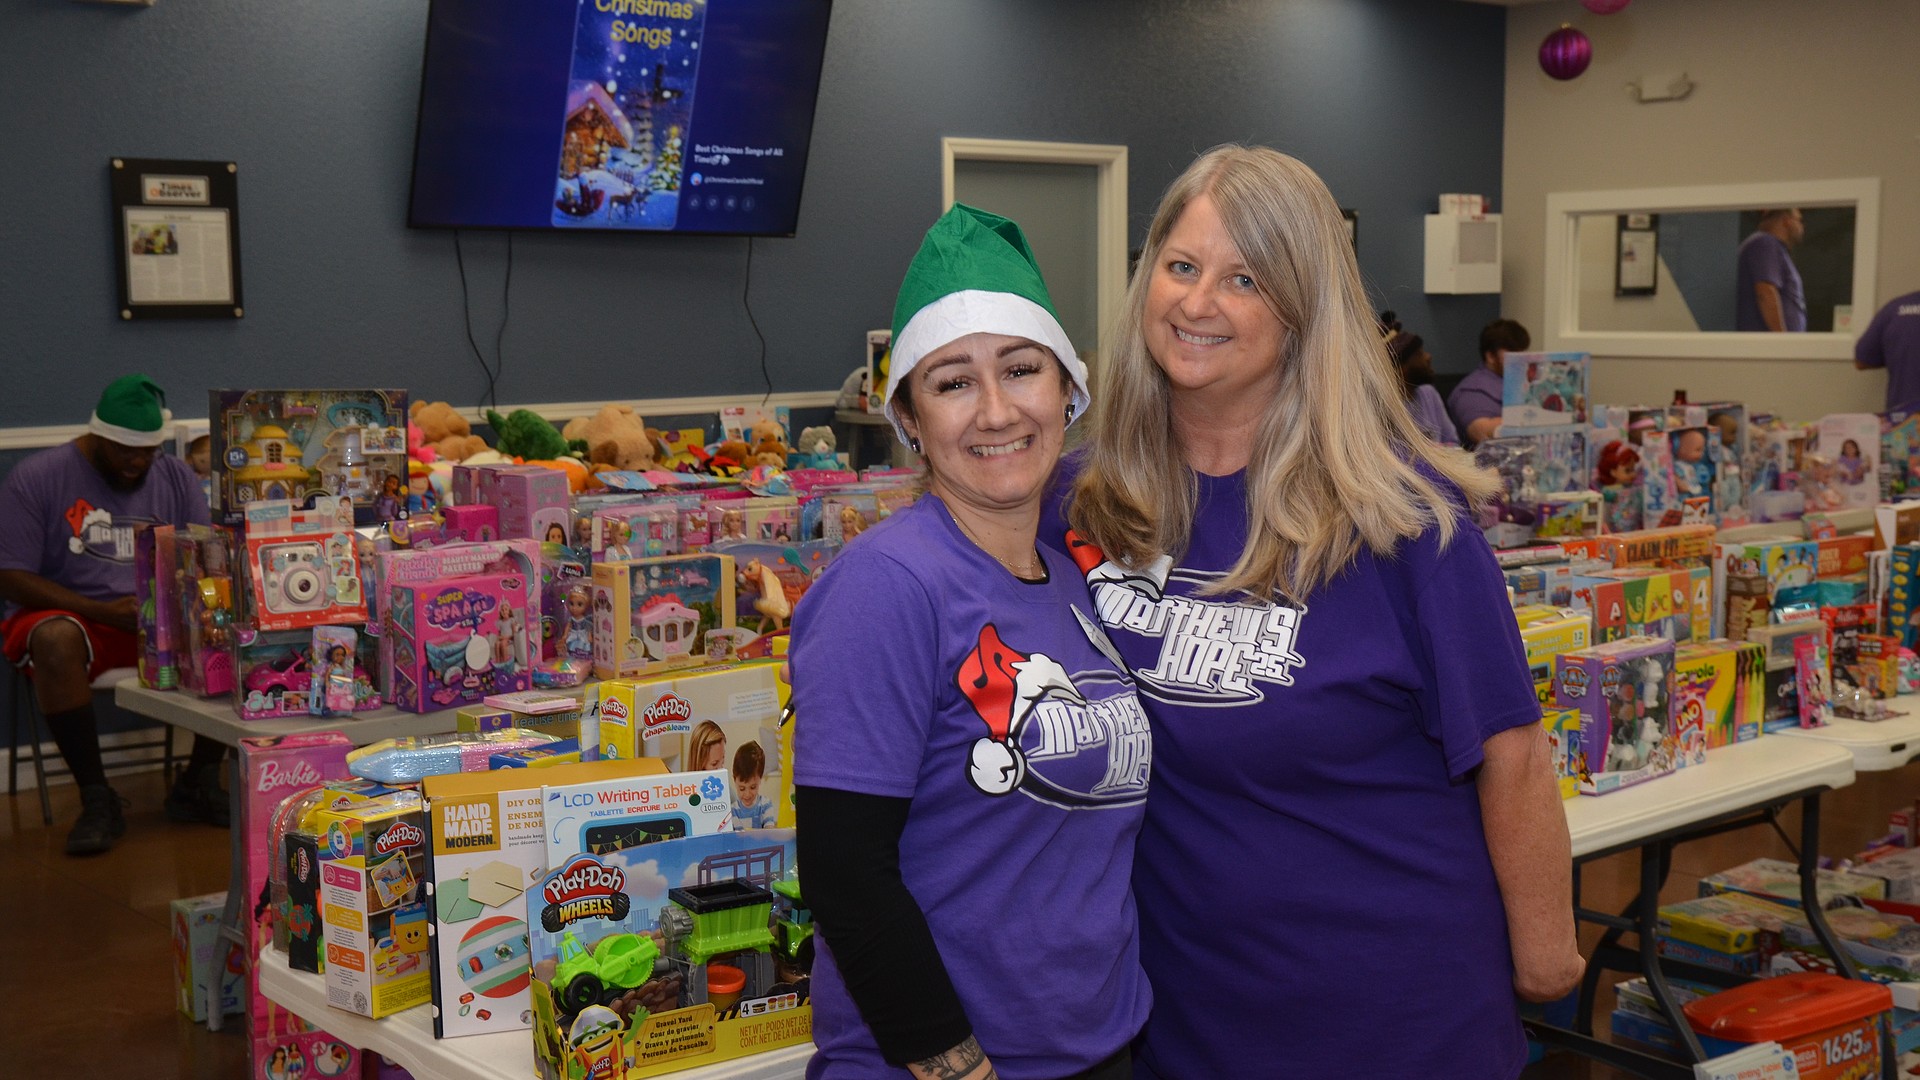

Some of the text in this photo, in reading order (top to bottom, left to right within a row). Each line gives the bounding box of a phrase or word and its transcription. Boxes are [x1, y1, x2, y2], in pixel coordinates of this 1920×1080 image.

[610, 20, 672, 49] Songs
[695, 144, 783, 157] Best Christmas Songs of All
[159, 182, 192, 190] Times
[1627, 541, 1661, 562] CLAIM
[437, 591, 463, 605] SUPER
[1694, 579, 1707, 611] 4
[1610, 602, 1621, 621] A
[1574, 631, 1583, 640] 12
[1141, 634, 1290, 697] HOPE 25
[601, 700, 627, 717] Play-Doh
[644, 697, 690, 724] Play-Doh
[1676, 704, 1699, 730] UNO
[645, 724, 690, 738] shape&learn
[1091, 733, 1151, 792] HOP
[258, 760, 319, 791] Barbie
[563, 783, 697, 808] LCD Writing Tablet
[705, 781, 719, 793] 3+
[443, 803, 491, 821] HAND
[507, 799, 525, 808] DIY
[589, 808, 624, 817] TABLETTE
[627, 804, 661, 814] ECRITURE
[703, 803, 726, 812] 10inch
[444, 818, 493, 838] MADE
[508, 822, 521, 830] DE
[377, 826, 420, 850] Play-Doh
[445, 834, 493, 848] MODERN
[546, 866, 622, 900] Play-Doh
[559, 898, 614, 923] WHEELS
[742, 1002, 750, 1015] 4
[656, 1016, 692, 1029] Gravel Yard
[740, 1026, 751, 1037] NET
[766, 1020, 785, 1033] POIDS
[786, 1017, 799, 1030] NET
[799, 1016, 808, 1027] DE
[645, 1040, 664, 1050] Grava
[670, 1032, 705, 1046] pavimento
[650, 1025, 699, 1039] Cour de gravier
[740, 1037, 758, 1049] CONT.
[773, 1032, 782, 1044] DE
[783, 1031, 790, 1041] LA
[642, 1040, 708, 1059] Terreno de Cascalho
[1823, 1029, 1863, 1066] 1625
